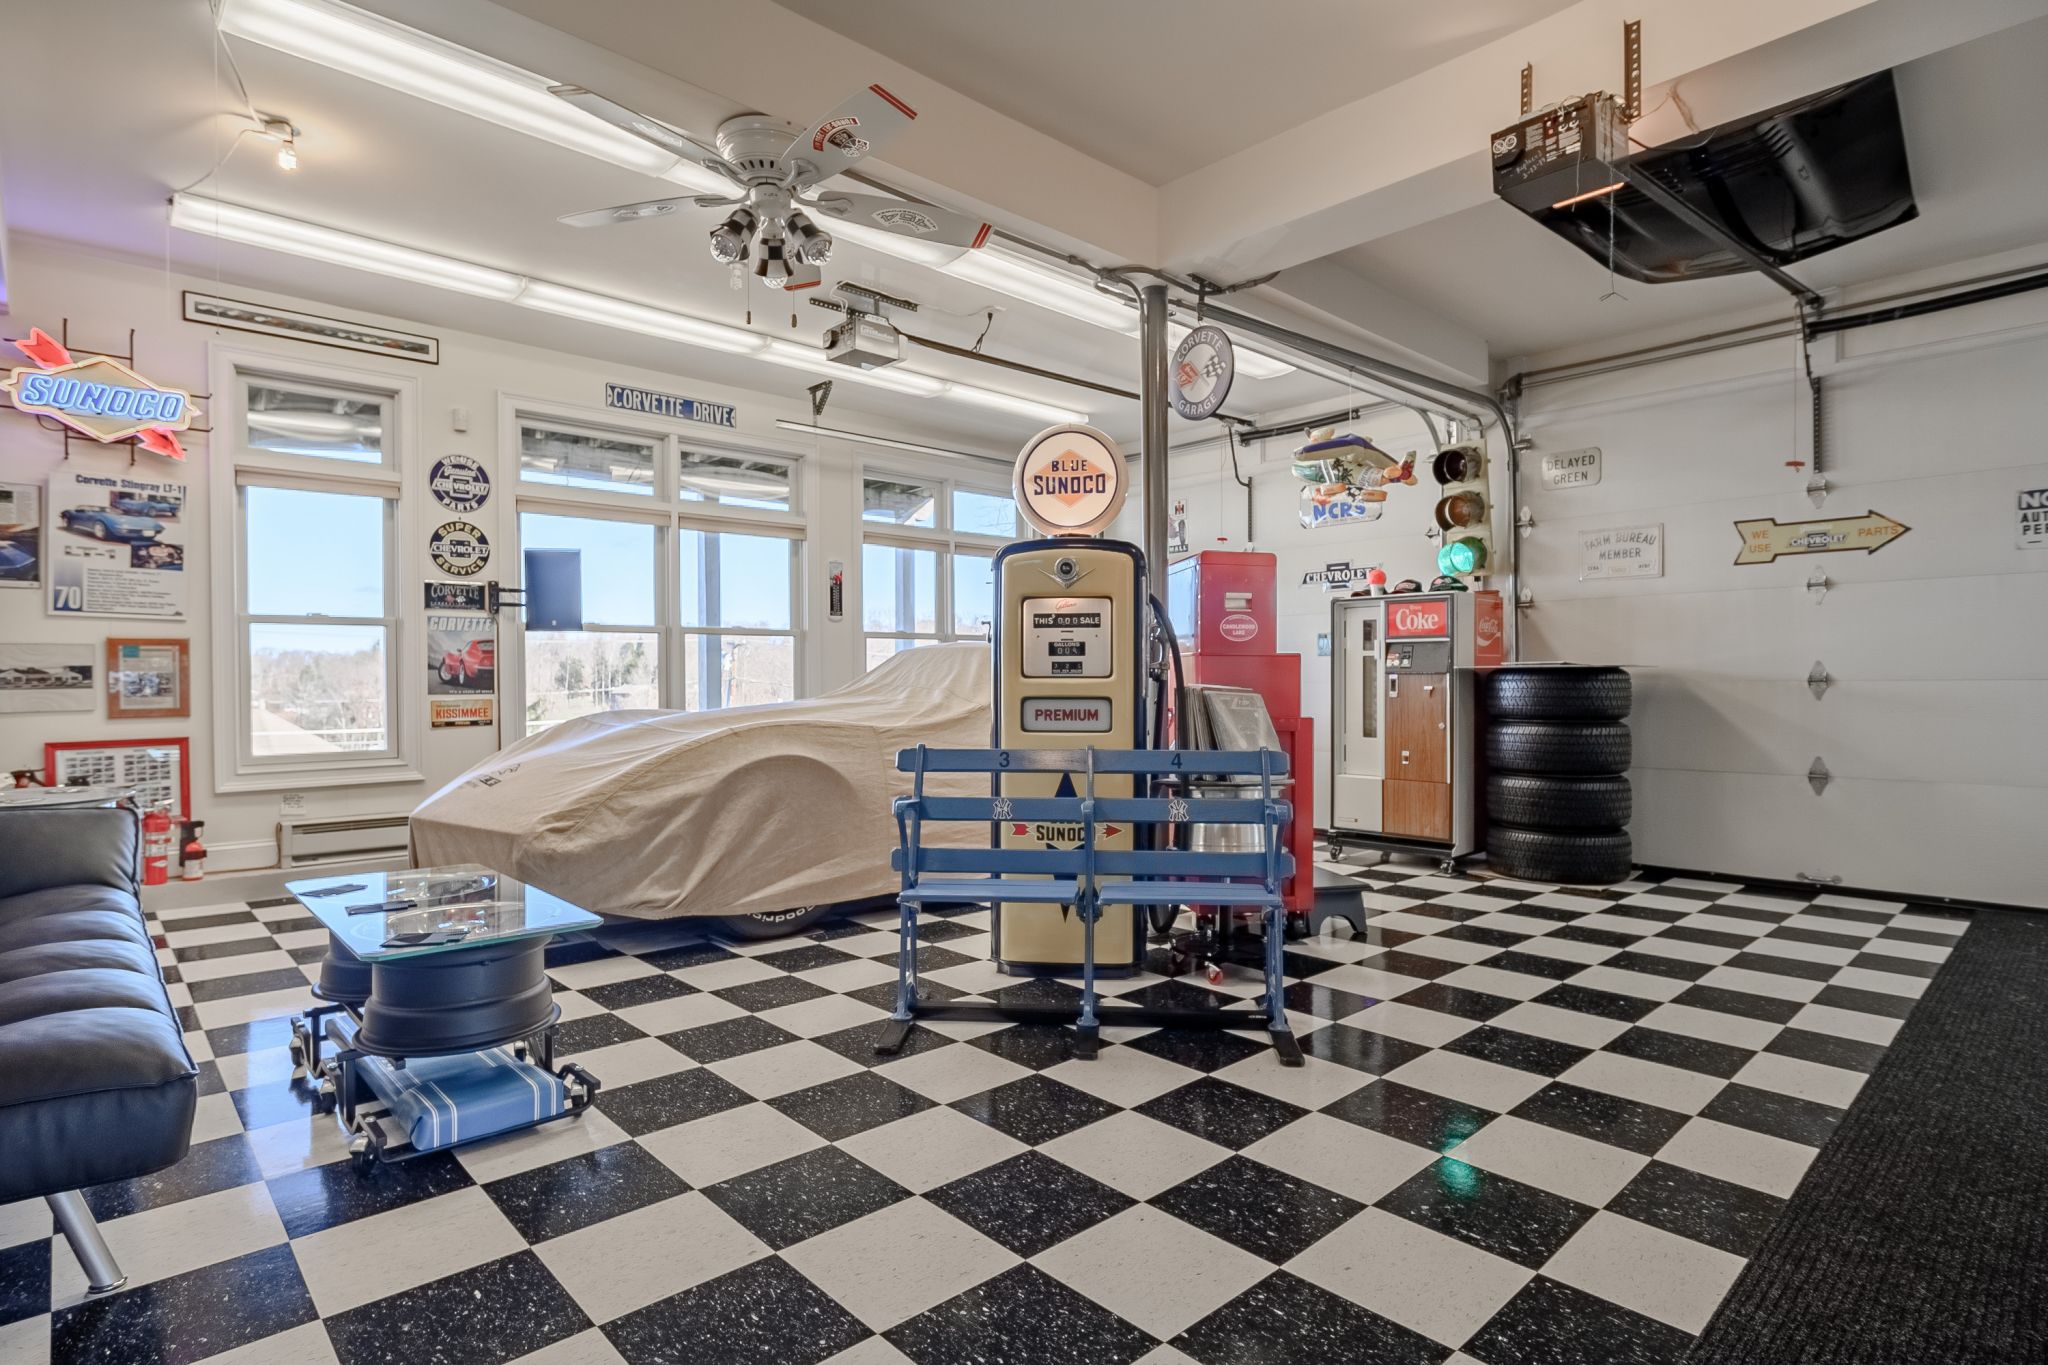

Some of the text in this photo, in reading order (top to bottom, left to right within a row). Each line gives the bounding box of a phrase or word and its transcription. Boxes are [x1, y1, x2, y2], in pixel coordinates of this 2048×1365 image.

[1177, 331, 1223, 362] CORVETTE
[22, 374, 185, 422] SUNOCO
[1178, 394, 1217, 415] GARAGE
[613, 387, 731, 426] CORVETTE DRIVE
[1051, 459, 1088, 472] BLUE
[1547, 454, 1596, 472] DELAYED
[75, 474, 118, 488] Corvette
[121, 479, 160, 494] Stingray
[1034, 473, 1106, 496] SUNOCO
[1553, 471, 1588, 485] GREEN
[435, 481, 486, 495] CHEVROLET
[442, 498, 479, 512] PARTS
[1313, 502, 1366, 521] NCRS
[438, 523, 481, 538] SUPER
[1752, 530, 1769, 539] WE
[1858, 525, 1899, 537] PARTS
[1616, 531, 1657, 546] BUREAU
[1791, 534, 1844, 546] CHEVROLET
[433, 544, 487, 555] CHEVROLET
[1599, 547, 1642, 560] MEMBER
[1750, 543, 1772, 553] USE
[436, 556, 485, 575] SERVICE
[1306, 568, 1372, 582] CHEVROLET
[55, 585, 82, 610] 70
[431, 584, 480, 600] CORVETTE
[430, 617, 492, 631] CORVETTE
[1034, 617, 1054, 625] THIS
[1080, 616, 1100, 624] SALE
[1395, 608, 1439, 630] Coke
[435, 707, 489, 720] KISSIMMEE
[1034, 709, 1099, 722] PREMIUM
[999, 752, 1010, 768] 3
[1171, 753, 1183, 769] 4
[1036, 823, 1087, 842] SUNOC
